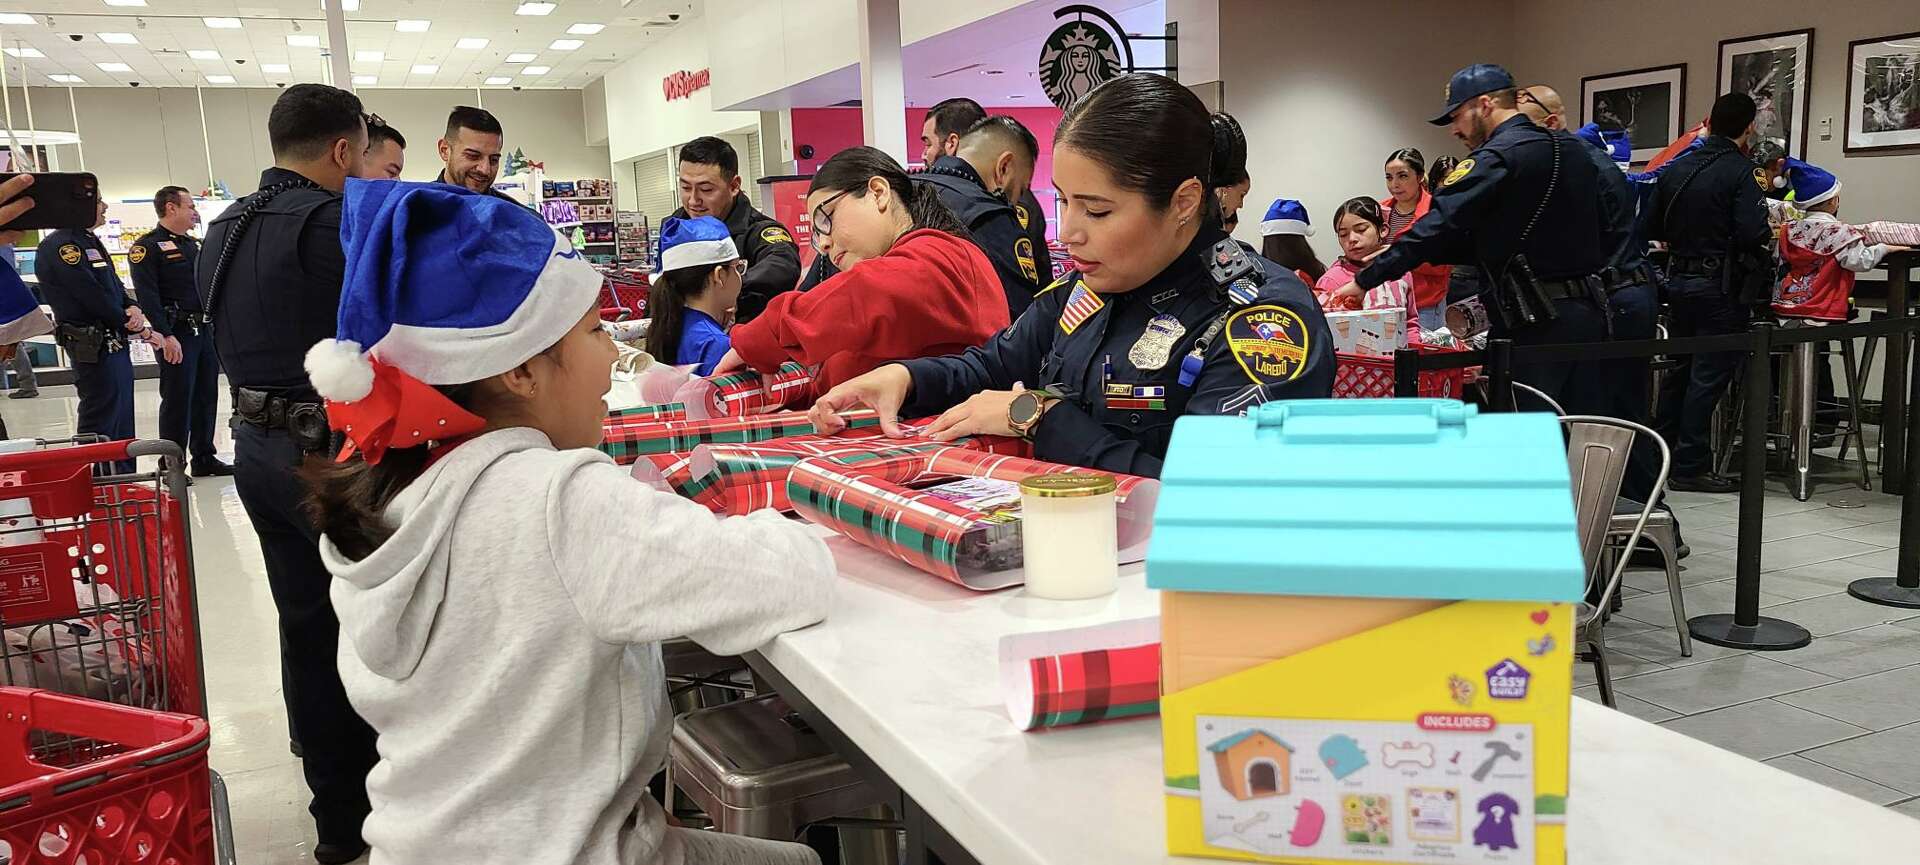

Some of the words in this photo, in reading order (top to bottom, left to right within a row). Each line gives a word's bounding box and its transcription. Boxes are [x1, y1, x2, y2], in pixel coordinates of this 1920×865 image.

[1246, 312, 1292, 328] POLICE
[1255, 355, 1287, 376] LAREDO
[1423, 715, 1491, 728] INCLUDES
